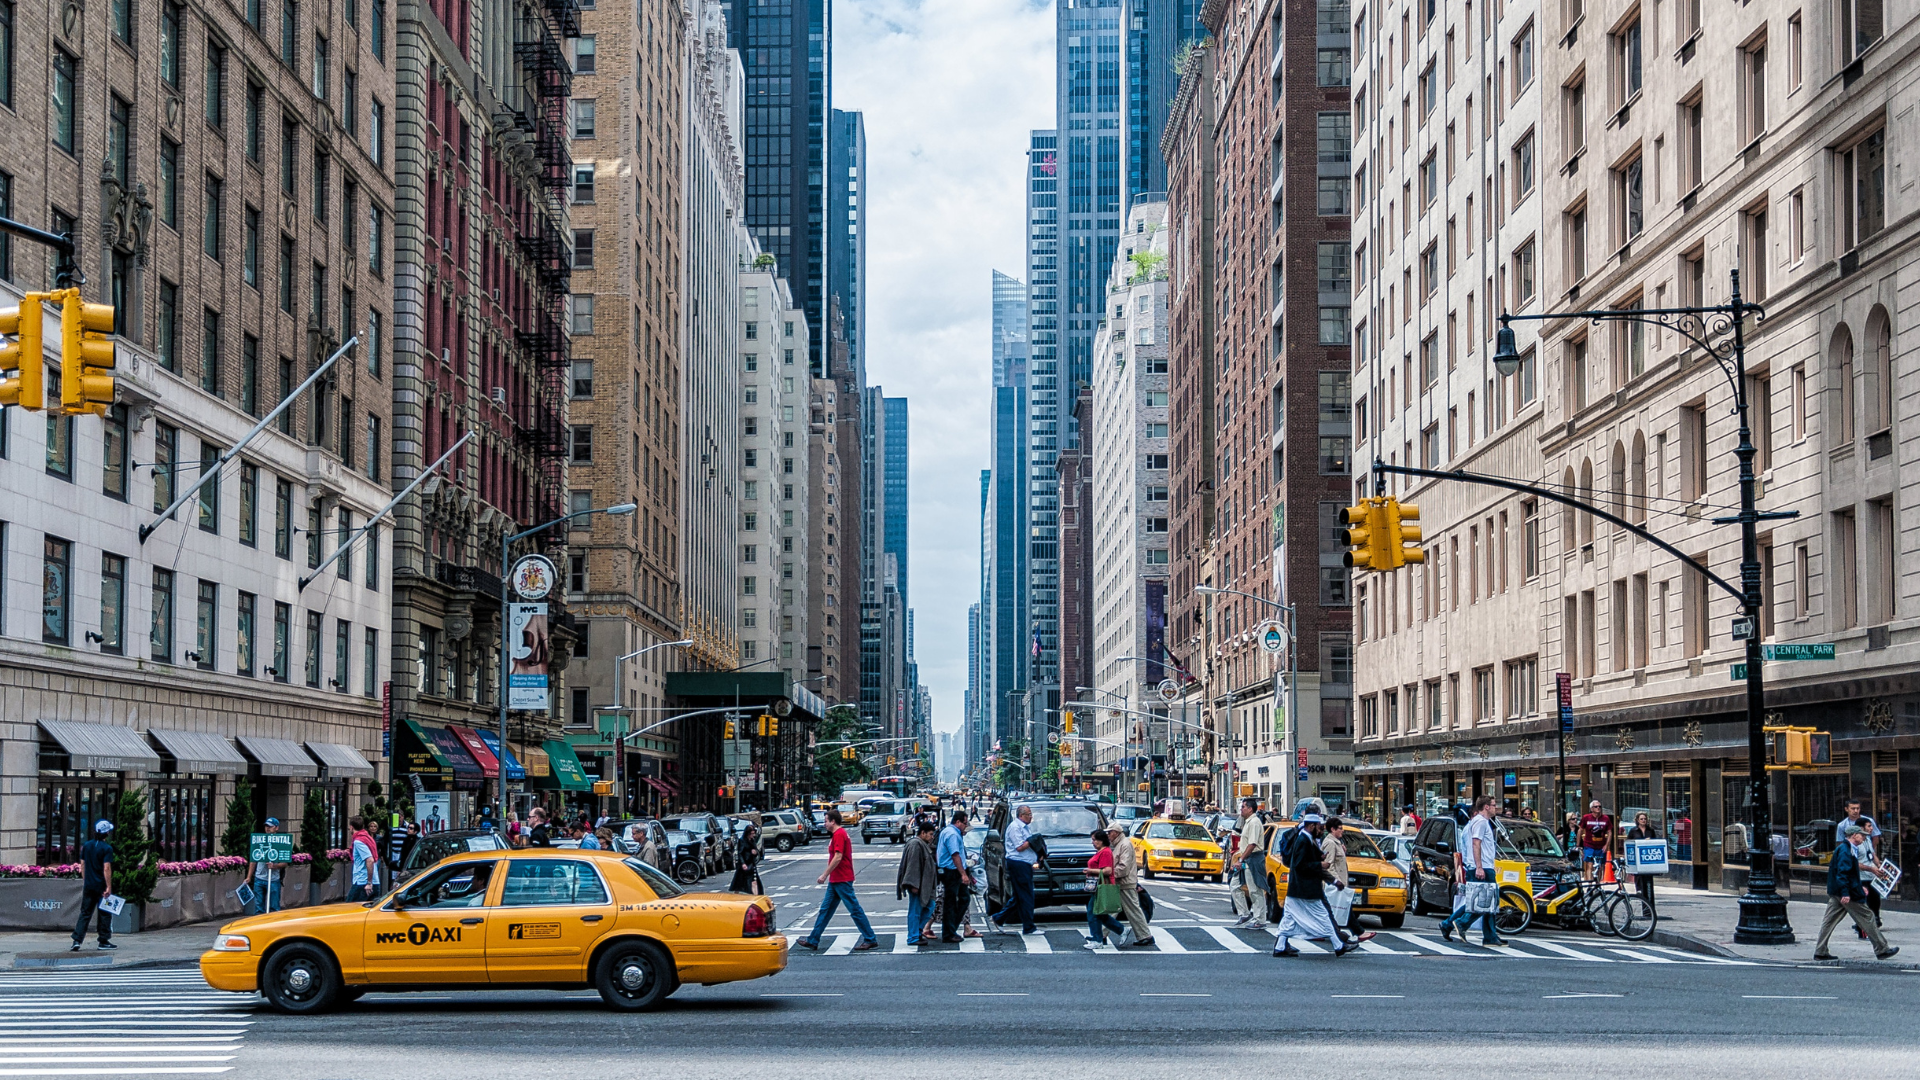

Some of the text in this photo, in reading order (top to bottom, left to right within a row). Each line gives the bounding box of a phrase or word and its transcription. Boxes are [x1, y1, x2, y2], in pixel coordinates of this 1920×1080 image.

[1775, 646, 1834, 655] CENTRAL PARK
[87, 756, 97, 768] BLT
[98, 758, 121, 768] MARKET
[252, 836, 291, 845] BIKE RENTAL
[24, 901, 63, 909] MARKET
[376, 926, 461, 944] NYC TAXI
